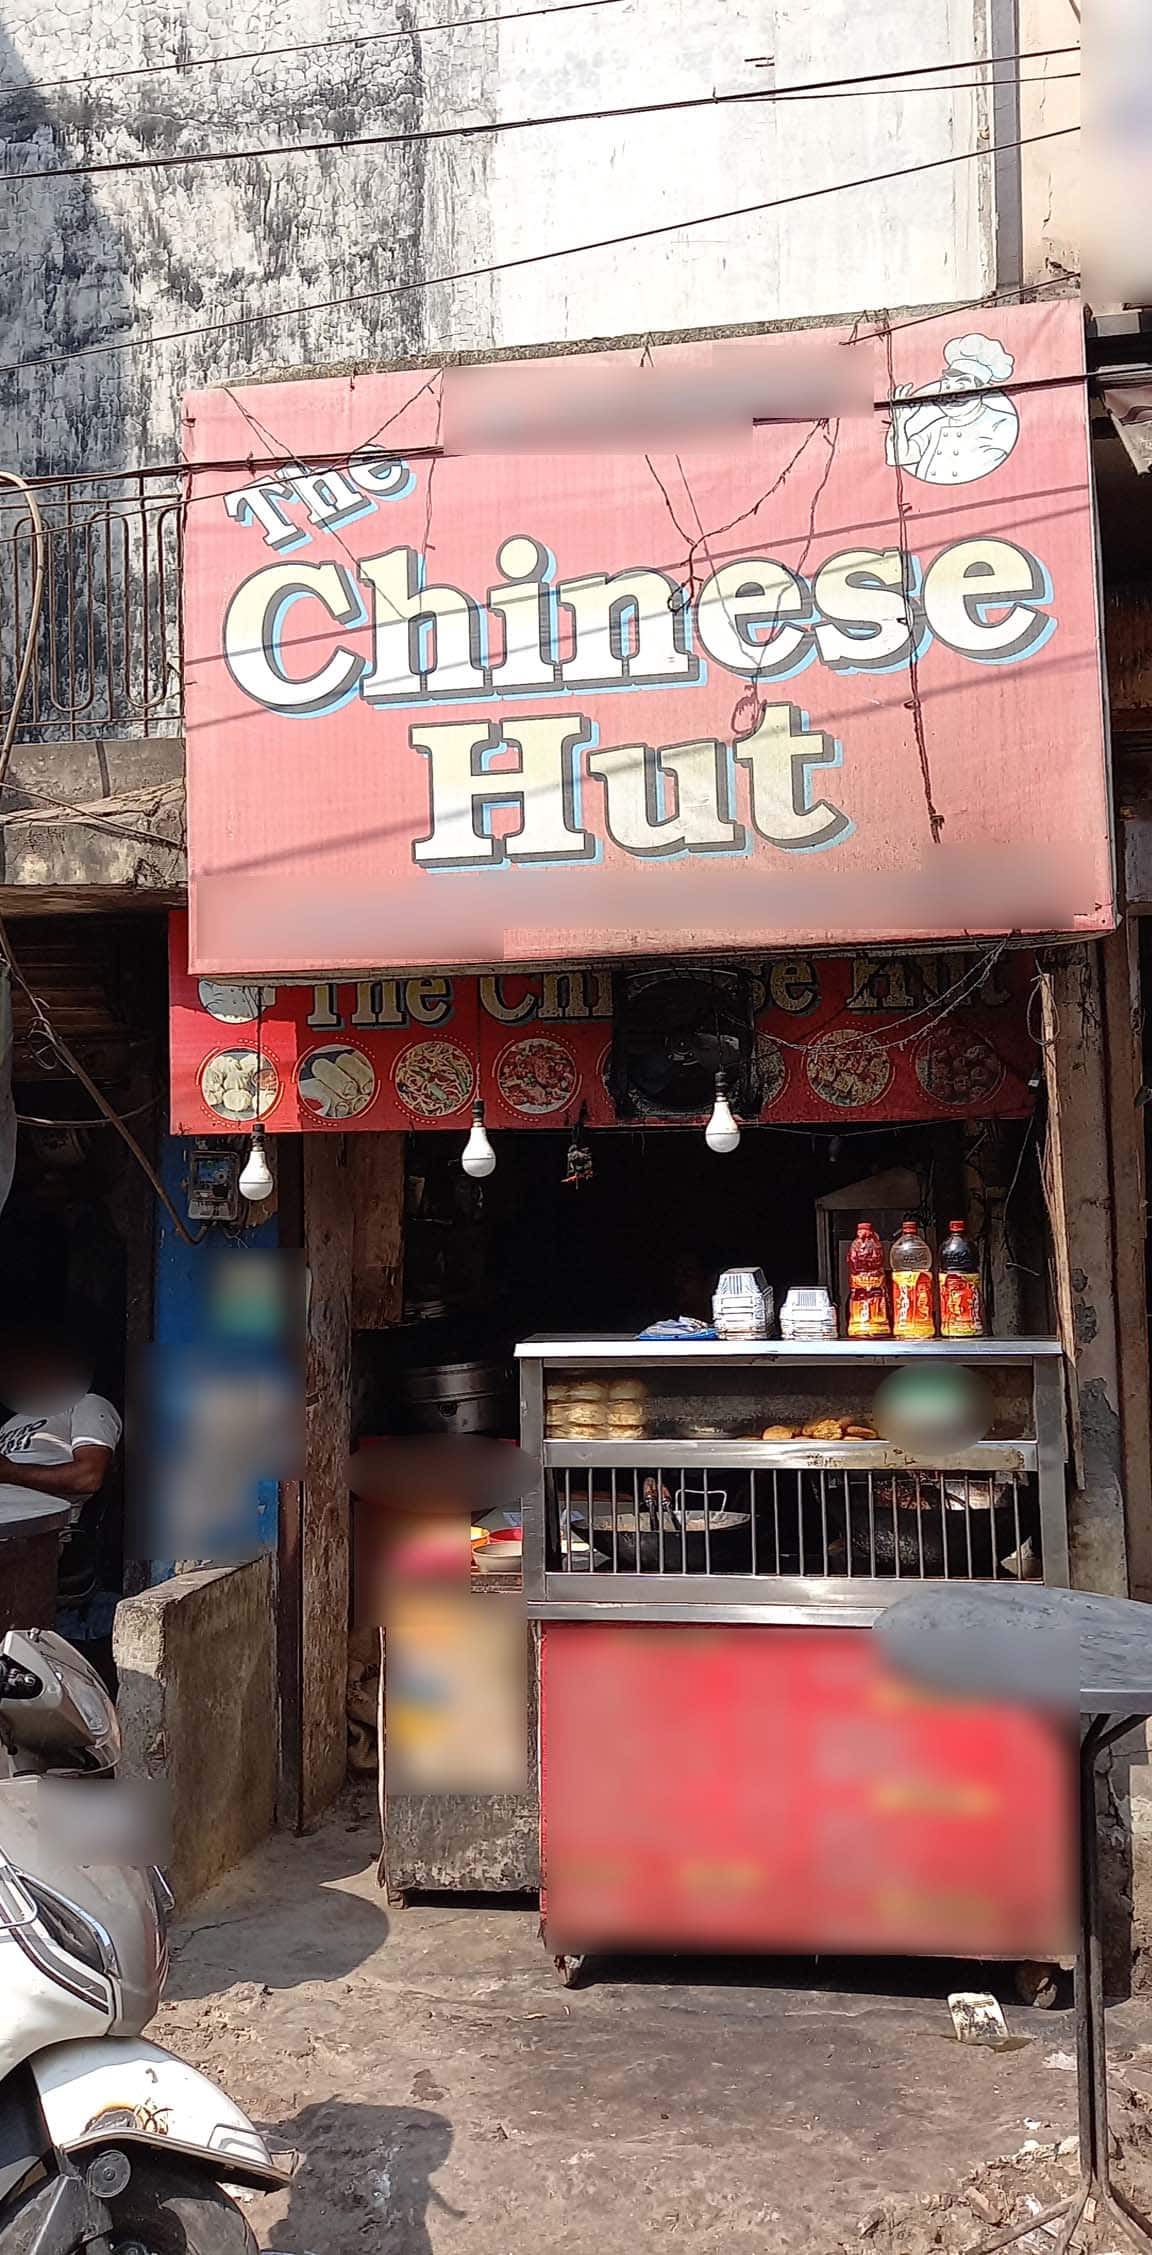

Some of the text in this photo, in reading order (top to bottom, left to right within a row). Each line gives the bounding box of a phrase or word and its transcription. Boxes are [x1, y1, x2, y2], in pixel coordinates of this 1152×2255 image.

[223, 444, 416, 554] The
[223, 534, 1056, 718] Chinese
[409, 701, 857, 872] Hut
[480, 957, 817, 1024] Chie
